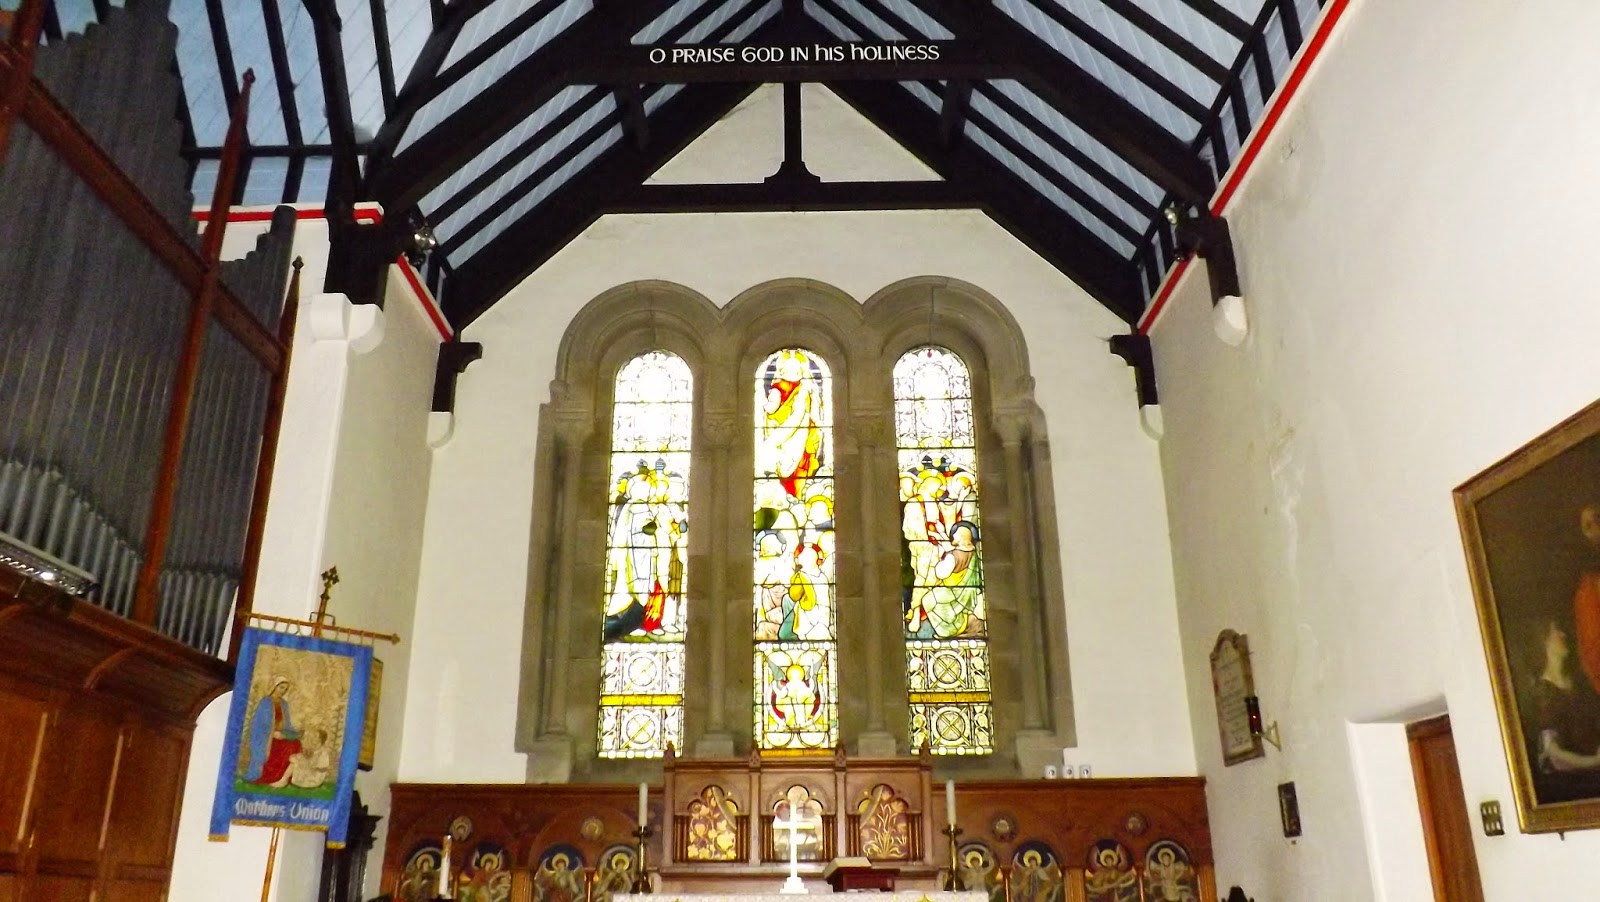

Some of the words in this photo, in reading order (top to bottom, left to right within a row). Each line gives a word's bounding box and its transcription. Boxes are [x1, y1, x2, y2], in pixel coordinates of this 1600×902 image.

[649, 48, 666, 64] O
[672, 47, 735, 63] PRAISE
[741, 46, 785, 63] GOD
[790, 46, 809, 62] IN
[235, 797, 285, 818] Mothers
[290, 802, 330, 821] Union
